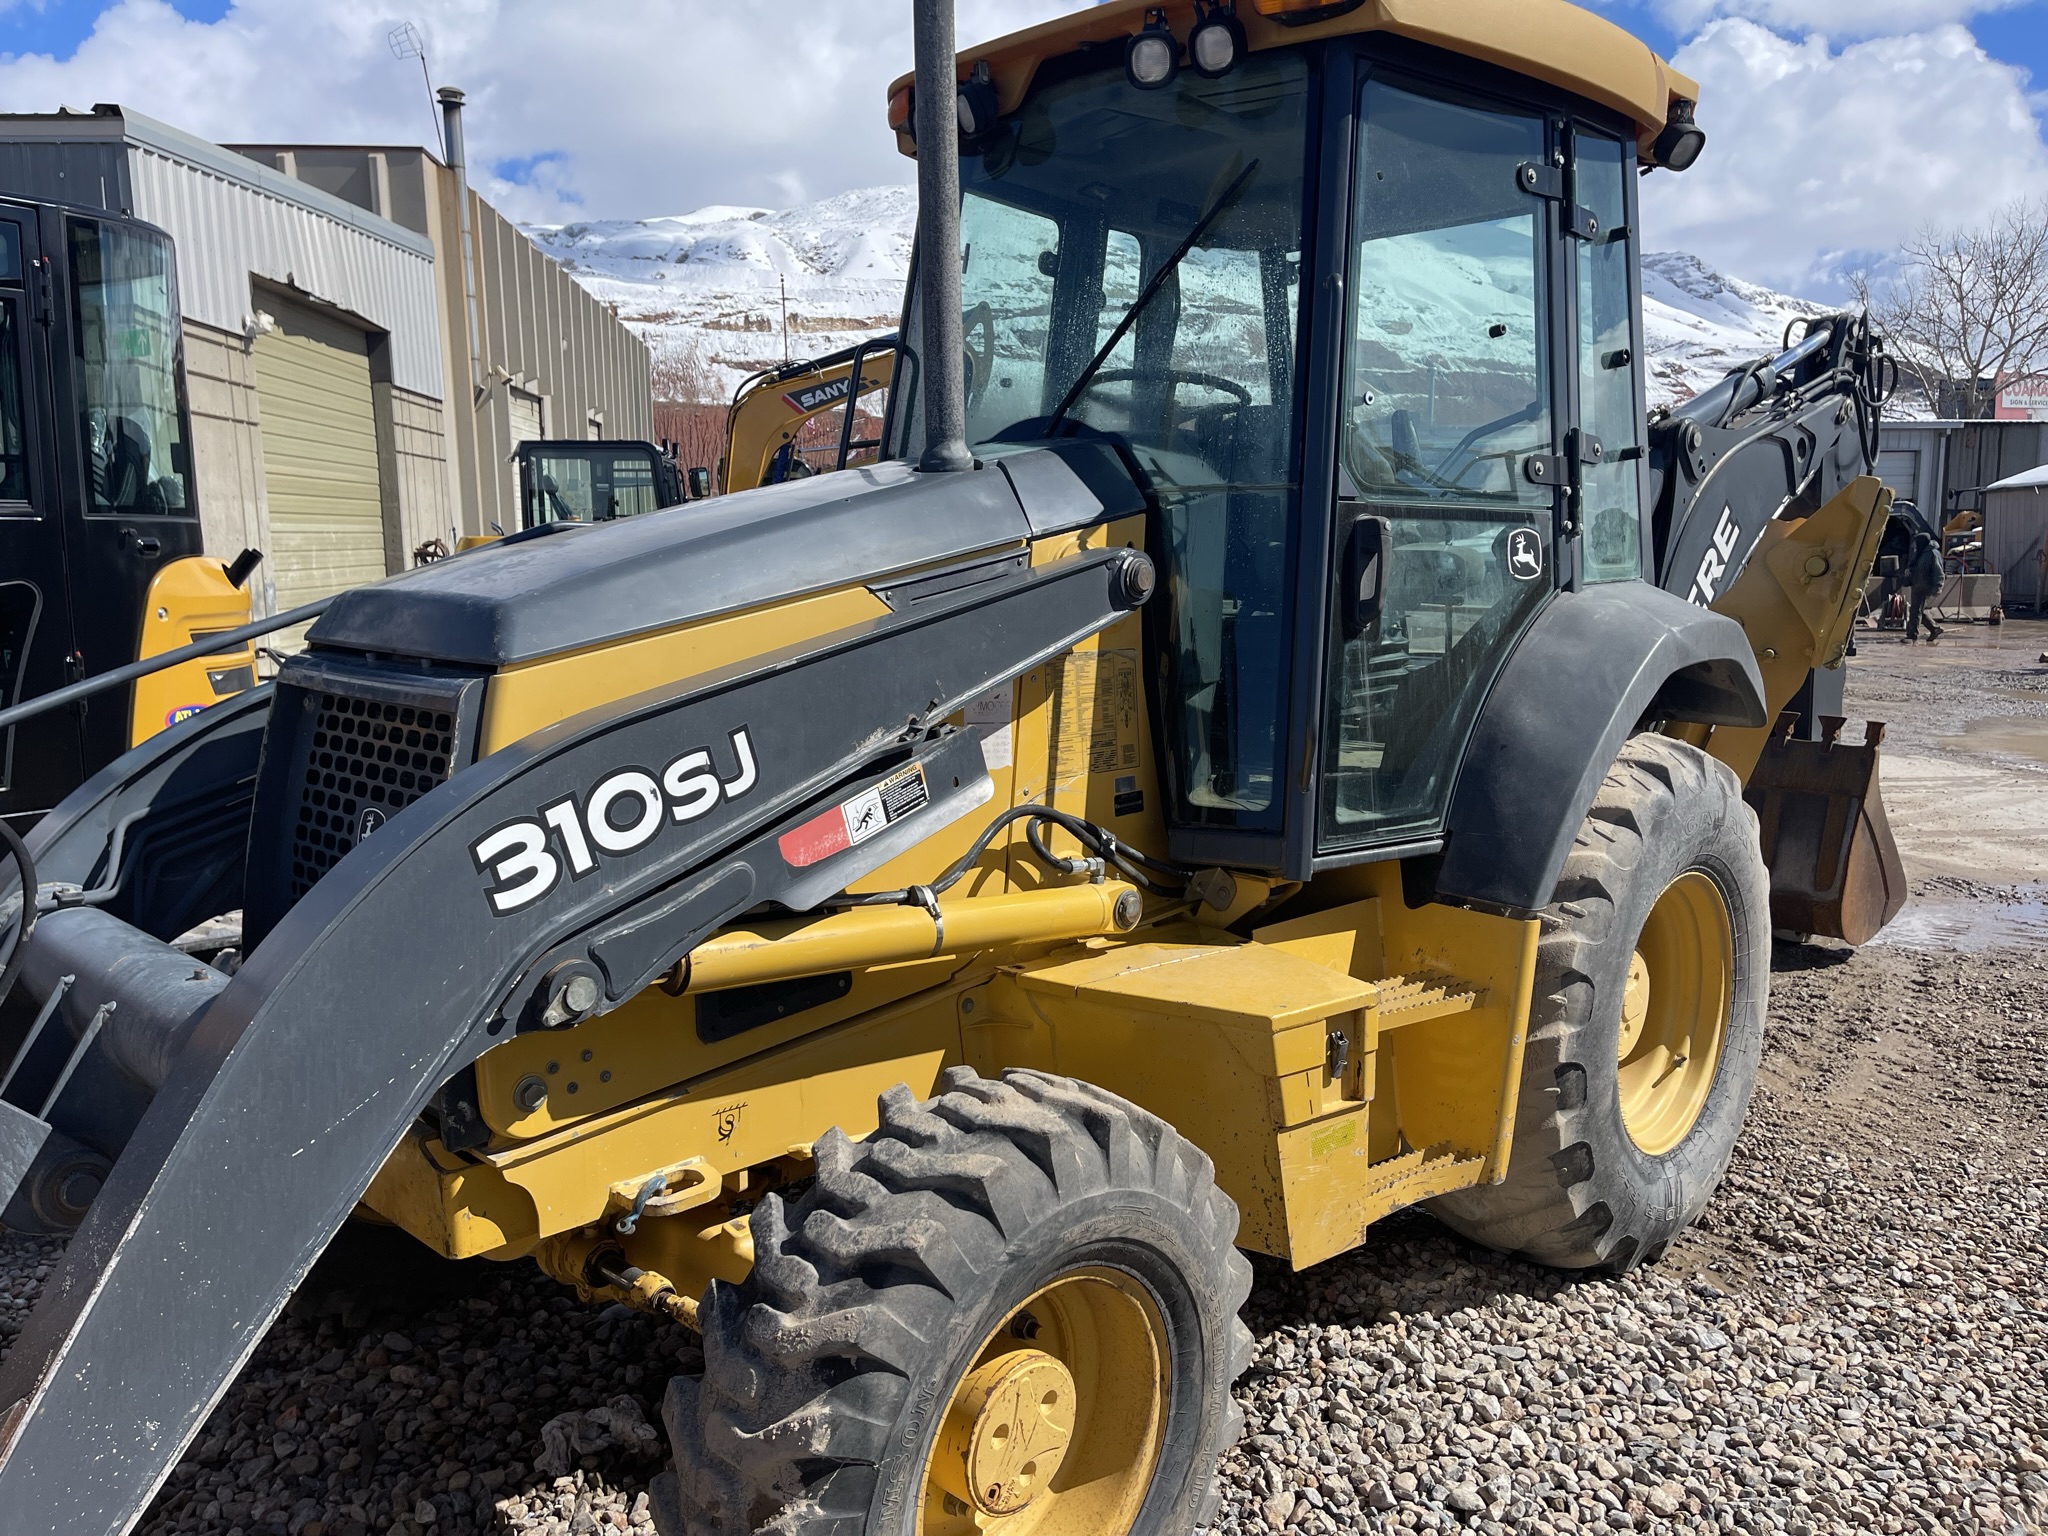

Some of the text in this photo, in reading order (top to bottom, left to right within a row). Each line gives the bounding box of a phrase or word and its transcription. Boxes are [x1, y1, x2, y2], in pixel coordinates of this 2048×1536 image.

[801, 379, 849, 407] SANY
[888, 764, 917, 784] WARNING
[475, 729, 757, 911] 310SJ
